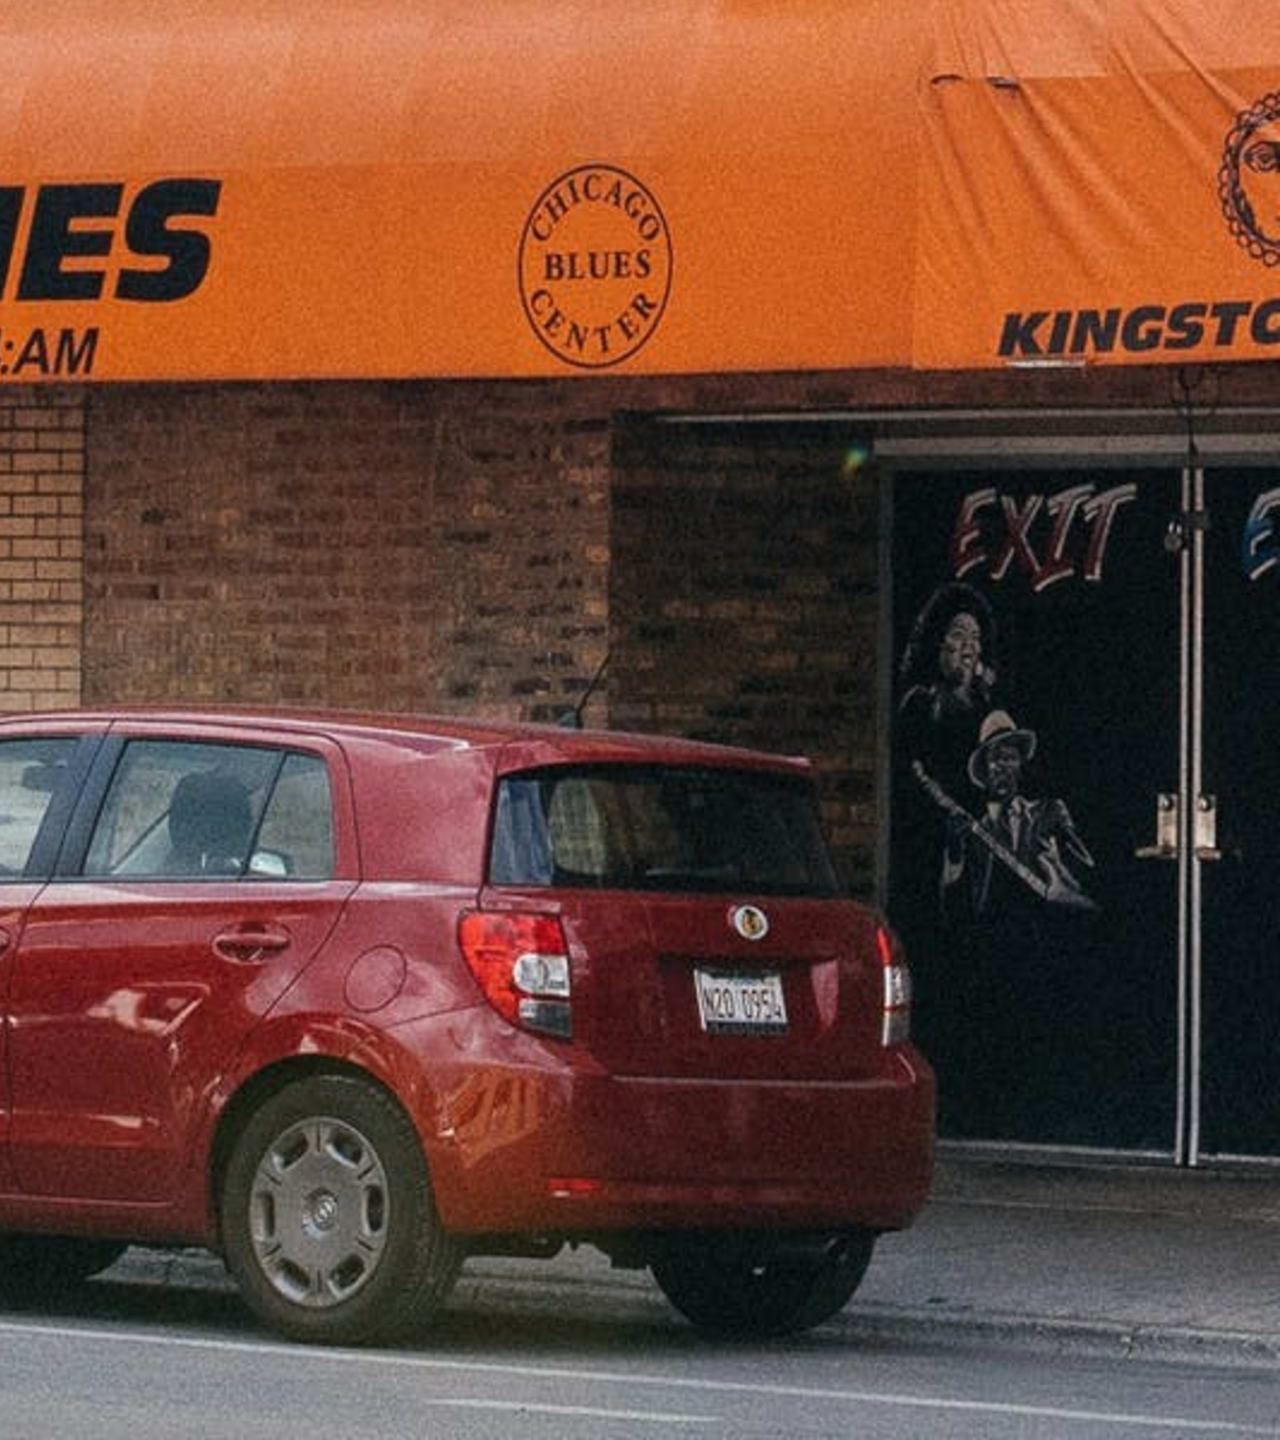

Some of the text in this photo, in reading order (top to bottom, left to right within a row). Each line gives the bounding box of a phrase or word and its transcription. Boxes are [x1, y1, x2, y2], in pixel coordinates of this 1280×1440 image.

[531, 173, 661, 242] CHICAGO
[544, 249, 652, 281] BLUES
[530, 289, 657, 353] CENTER
[949, 482, 1137, 592] EXIT
